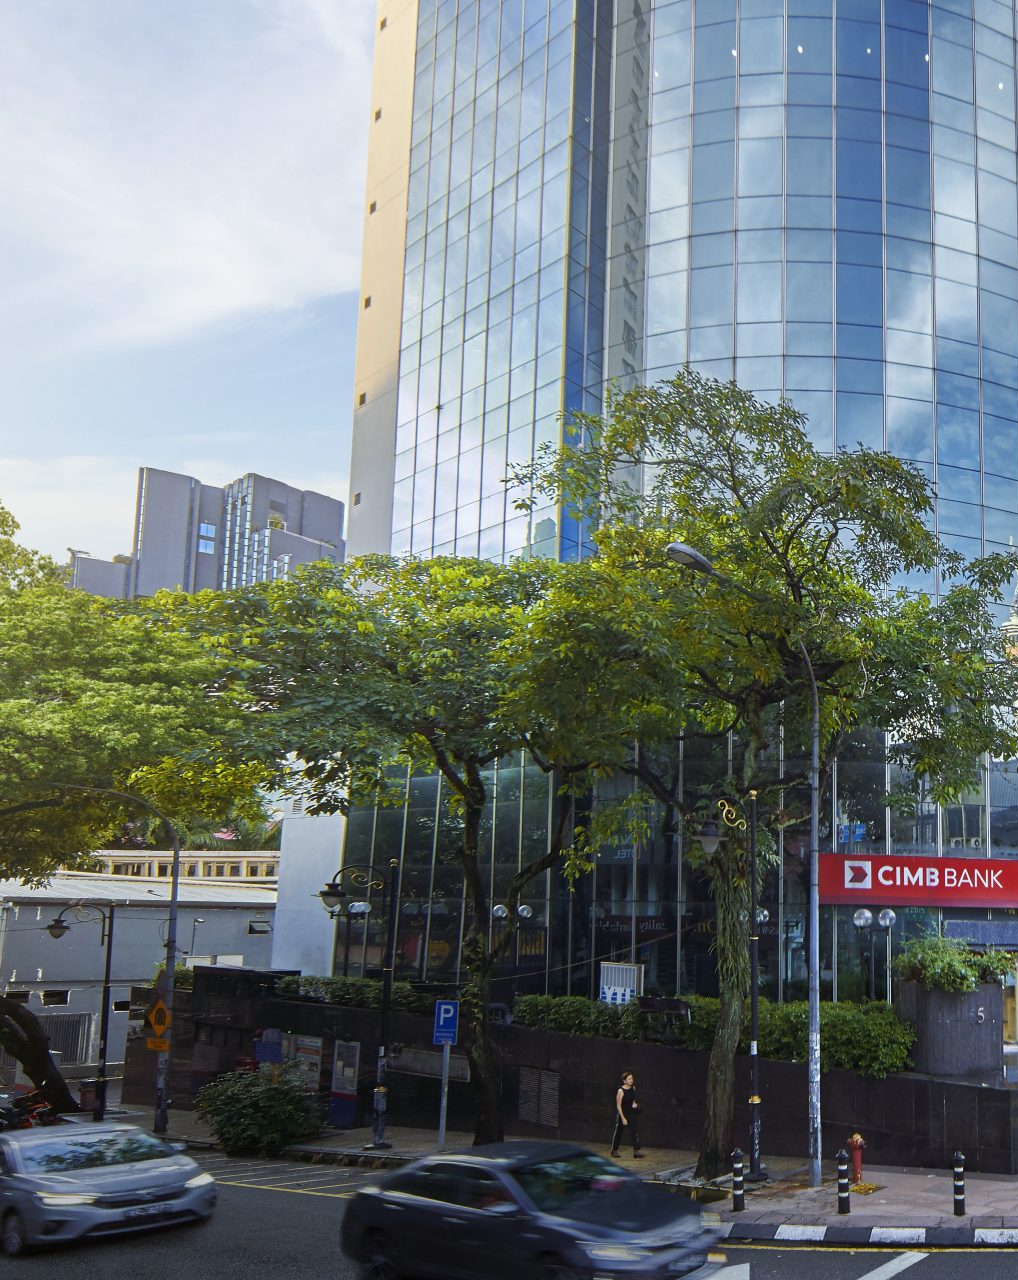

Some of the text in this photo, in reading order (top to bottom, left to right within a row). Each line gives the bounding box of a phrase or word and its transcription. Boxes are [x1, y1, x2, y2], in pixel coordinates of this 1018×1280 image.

[877, 865, 1003, 889] CIMB BANK
[440, 1004, 454, 1025] P
[977, 1007, 985, 1023] 5
